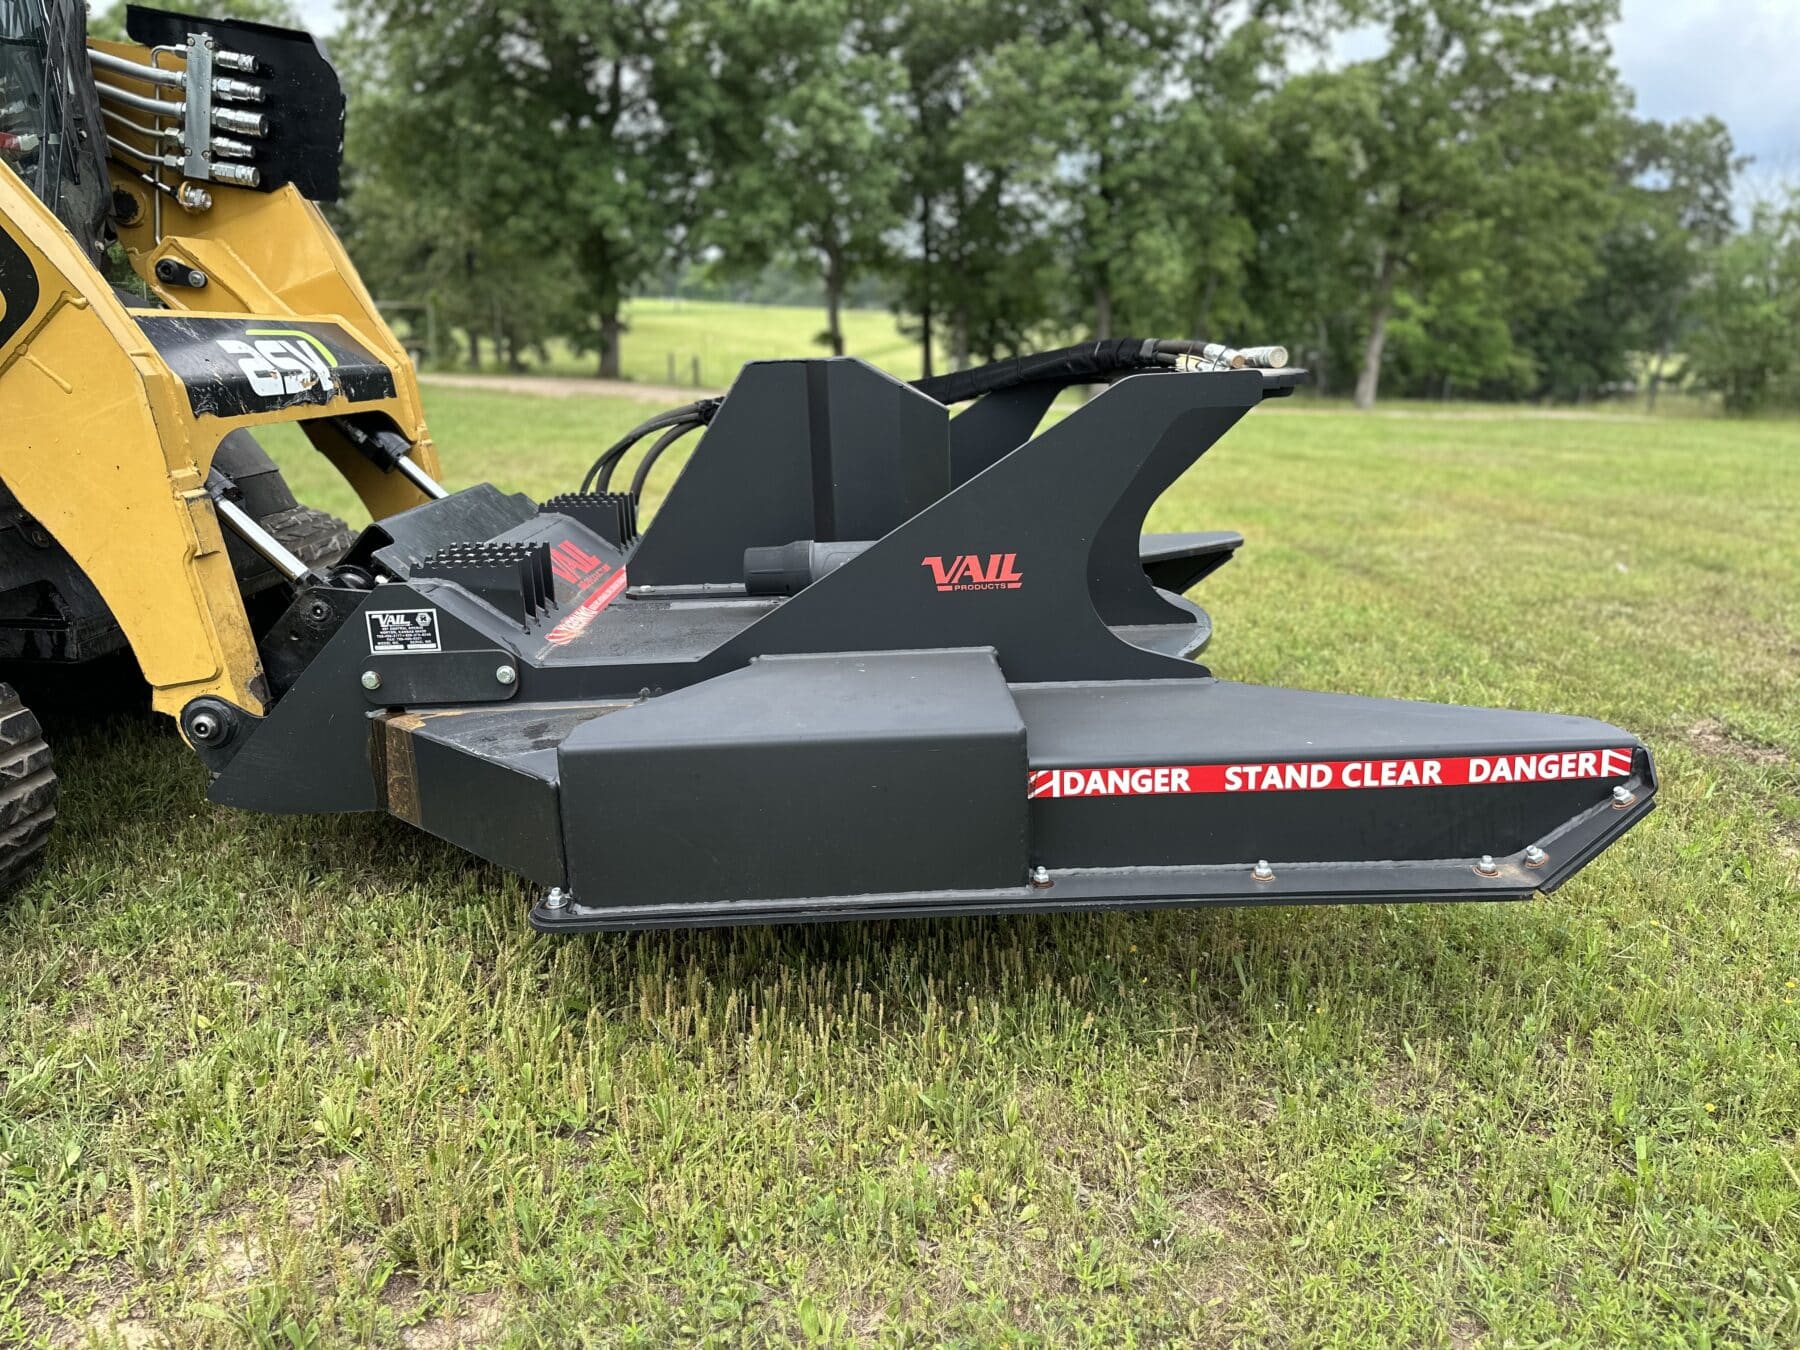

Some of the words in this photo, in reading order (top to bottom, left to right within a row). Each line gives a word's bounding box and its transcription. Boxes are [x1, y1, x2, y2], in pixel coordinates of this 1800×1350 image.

[921, 553, 1023, 584] VAIL
[954, 582, 1007, 591] PRODUCTS
[371, 614, 411, 626] VAIL
[1063, 768, 1191, 795] DANGER
[1224, 764, 1332, 790] STAND
[1341, 760, 1443, 787] CLEAR
[1468, 752, 1598, 783] DANGER
